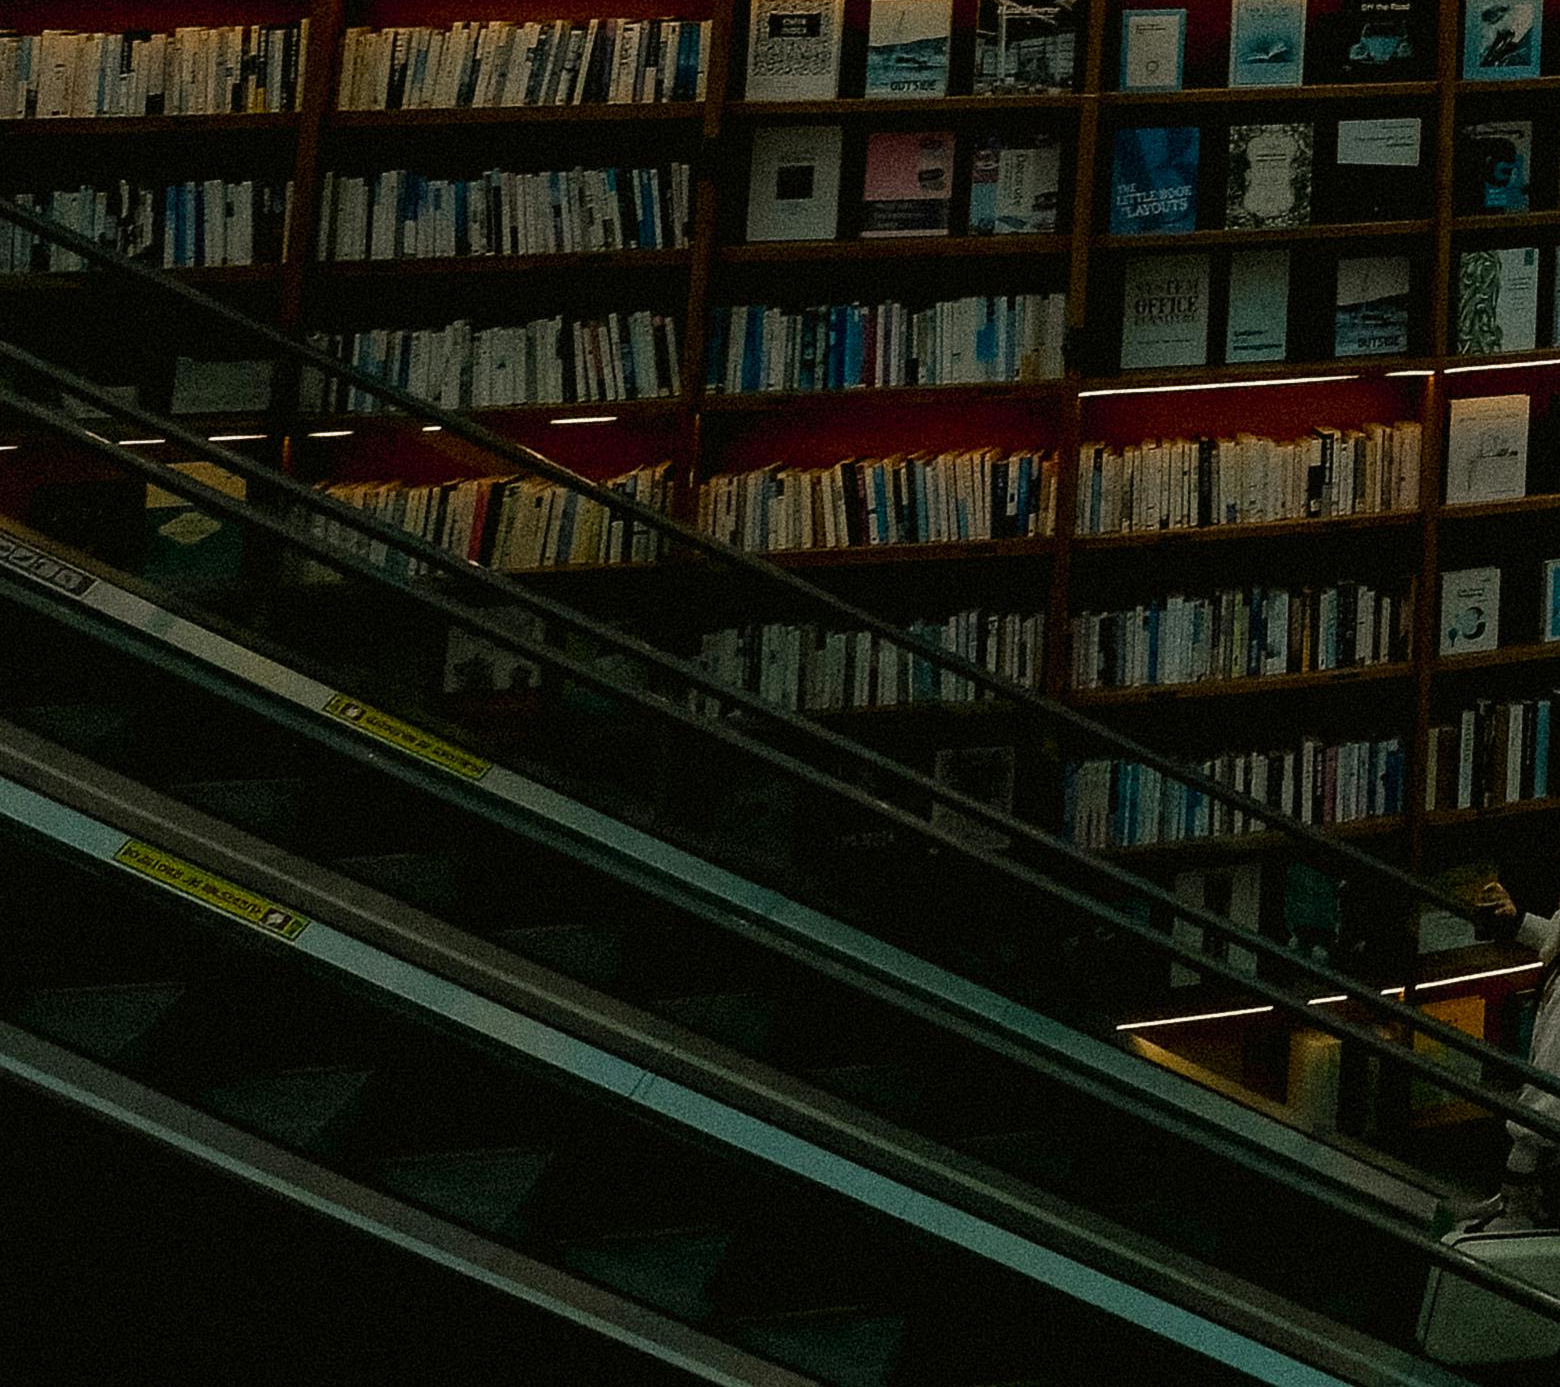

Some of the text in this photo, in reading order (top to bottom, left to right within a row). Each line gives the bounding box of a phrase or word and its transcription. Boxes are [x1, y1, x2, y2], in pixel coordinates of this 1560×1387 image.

[890, 78, 937, 92] OUTSIDE
[1116, 184, 1192, 206] LITTLE BOOK
[1127, 198, 1189, 219] LAYOUTS
[1135, 296, 1199, 315] OFFICE
[1357, 334, 1402, 348] OUTSIDE
